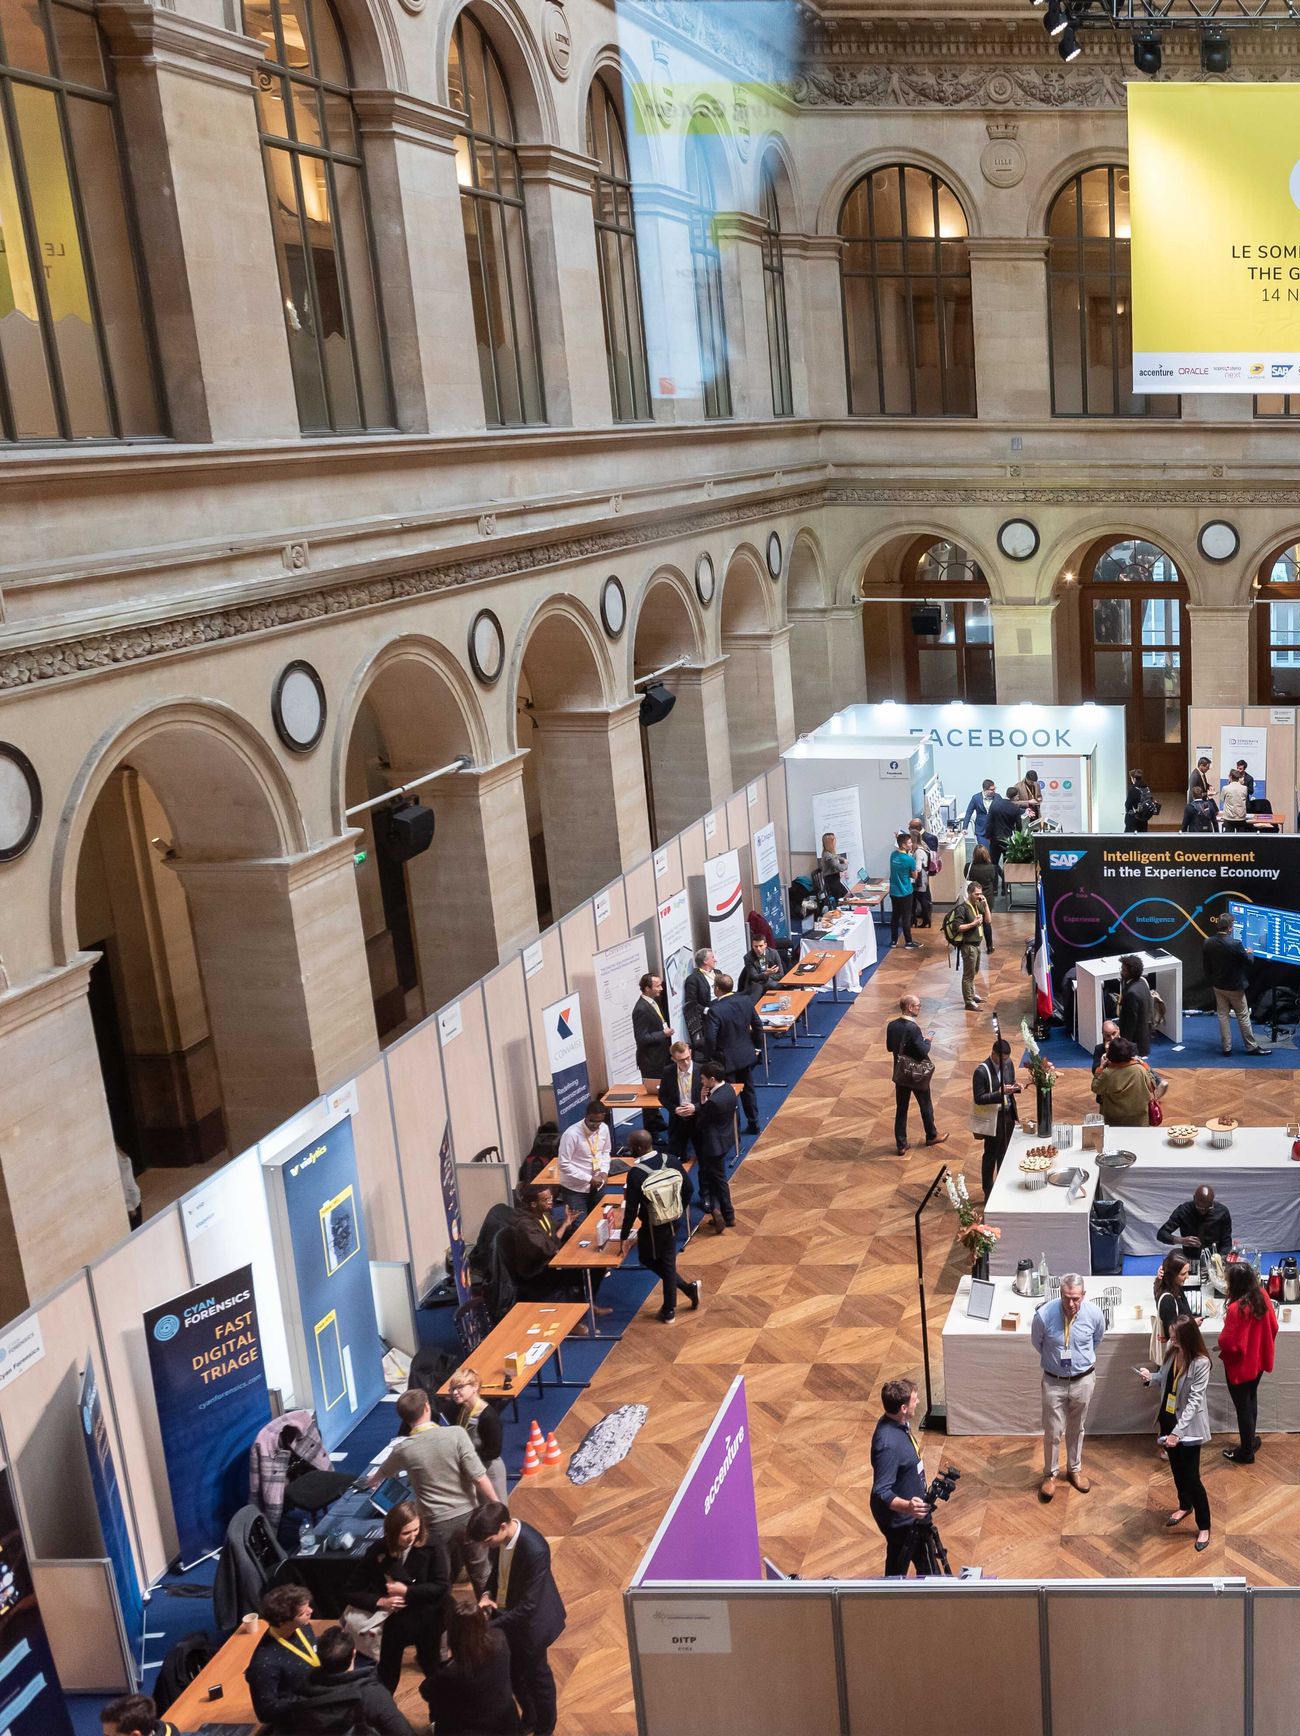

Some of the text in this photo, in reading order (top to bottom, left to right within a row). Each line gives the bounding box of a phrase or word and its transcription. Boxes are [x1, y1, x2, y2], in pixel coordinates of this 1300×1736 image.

[1231, 245, 1252, 259] LE
[1247, 266, 1282, 281] THE
[1262, 288, 1281, 302] 14
[1139, 366, 1174, 377] accenture
[1178, 367, 1209, 375] ORACLE
[1272, 365, 1288, 376] SAP
[1050, 853, 1079, 867] SAP
[1103, 850, 1255, 864] Intelligent Government
[1103, 866, 1280, 880] in the Experience Economy
[556, 1078, 579, 1096] Redefining
[183, 1297, 216, 1318] CYAN
[184, 1290, 251, 1328] FORENSICS
[214, 1311, 253, 1340] FAST
[192, 1331, 257, 1371] DIGITAL
[200, 1347, 258, 1385] TRIAGE
[198, 1374, 262, 1410] cyanforensics.com
[704, 1425, 745, 1516] accenture
[672, 1636, 697, 1644] DITP
